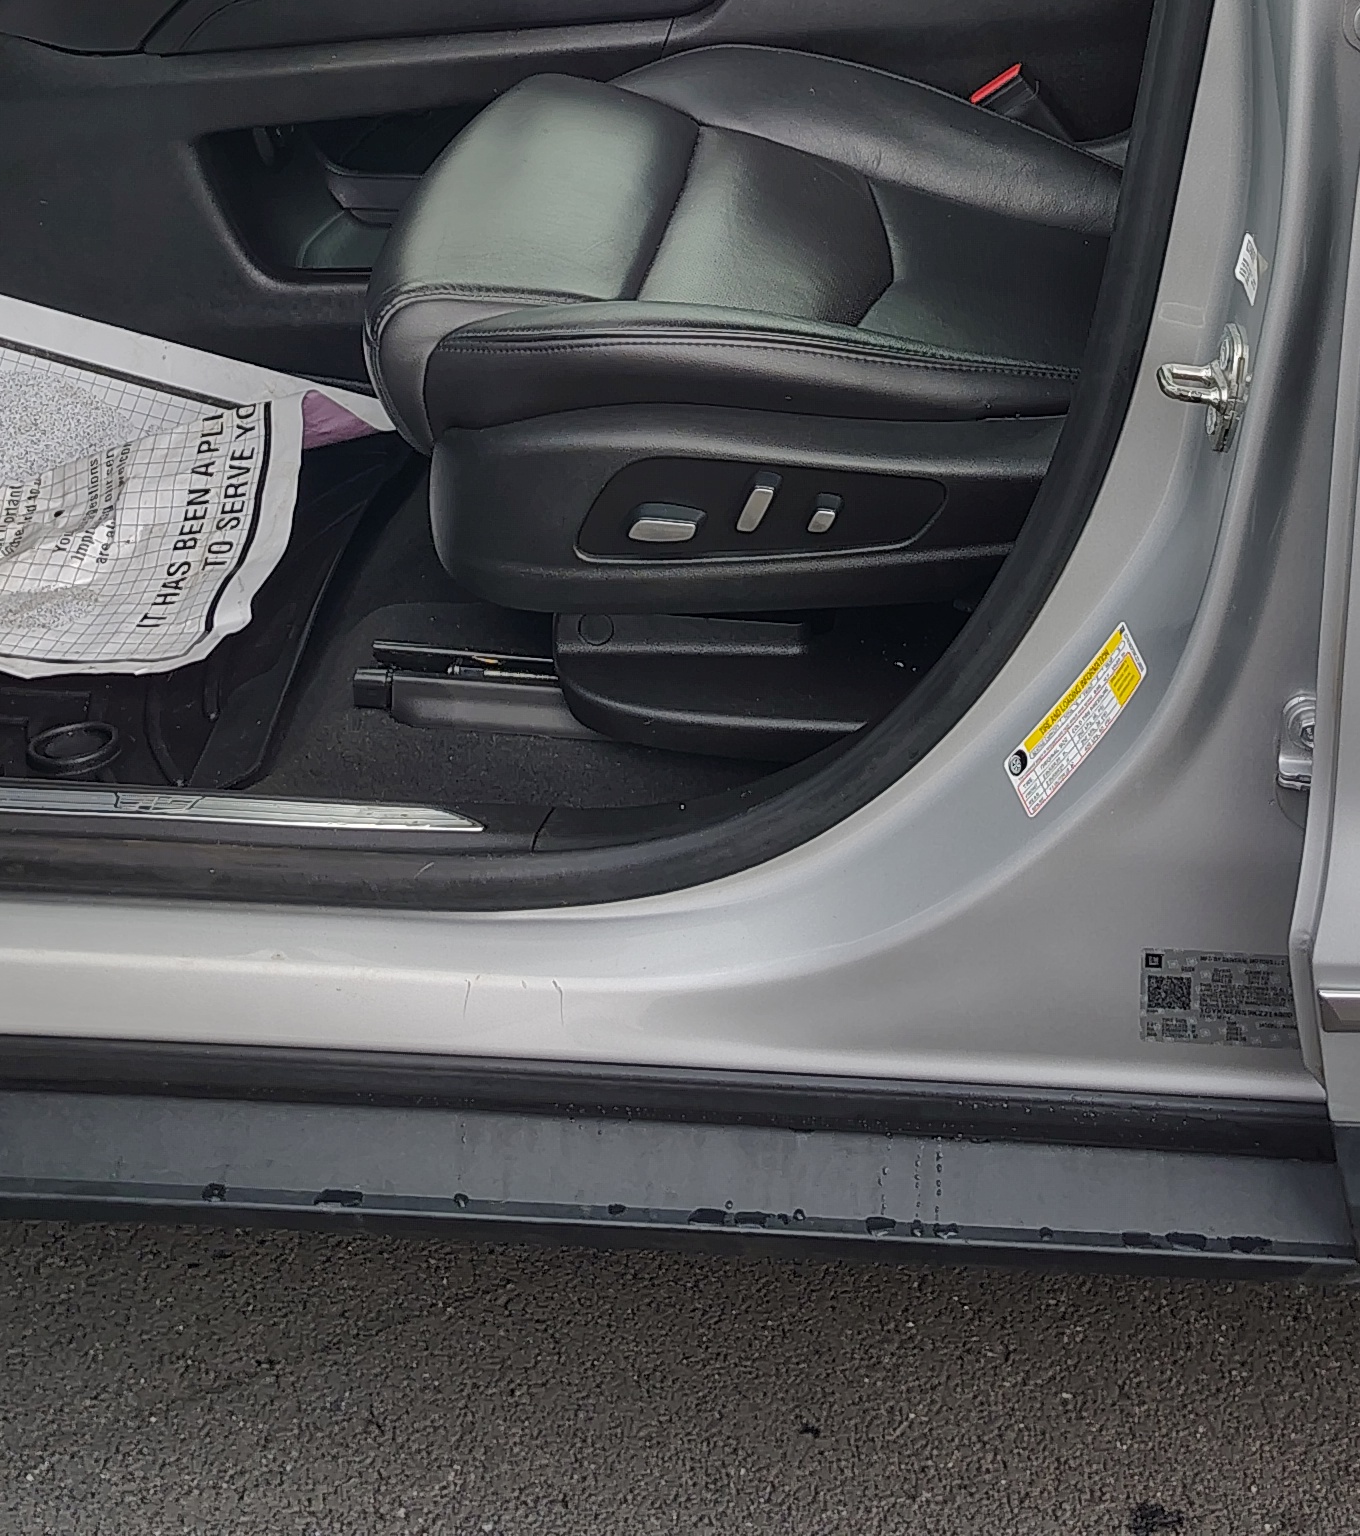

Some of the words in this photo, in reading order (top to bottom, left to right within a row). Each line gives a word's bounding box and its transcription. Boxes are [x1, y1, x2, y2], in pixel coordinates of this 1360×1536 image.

[192, 460, 217, 478] A
[216, 446, 256, 531] SERVE
[173, 487, 211, 552] BEEN
[96, 542, 111, 565] are
[201, 540, 235, 572] TO
[151, 560, 192, 607] HAS
[136, 612, 168, 629] IT
